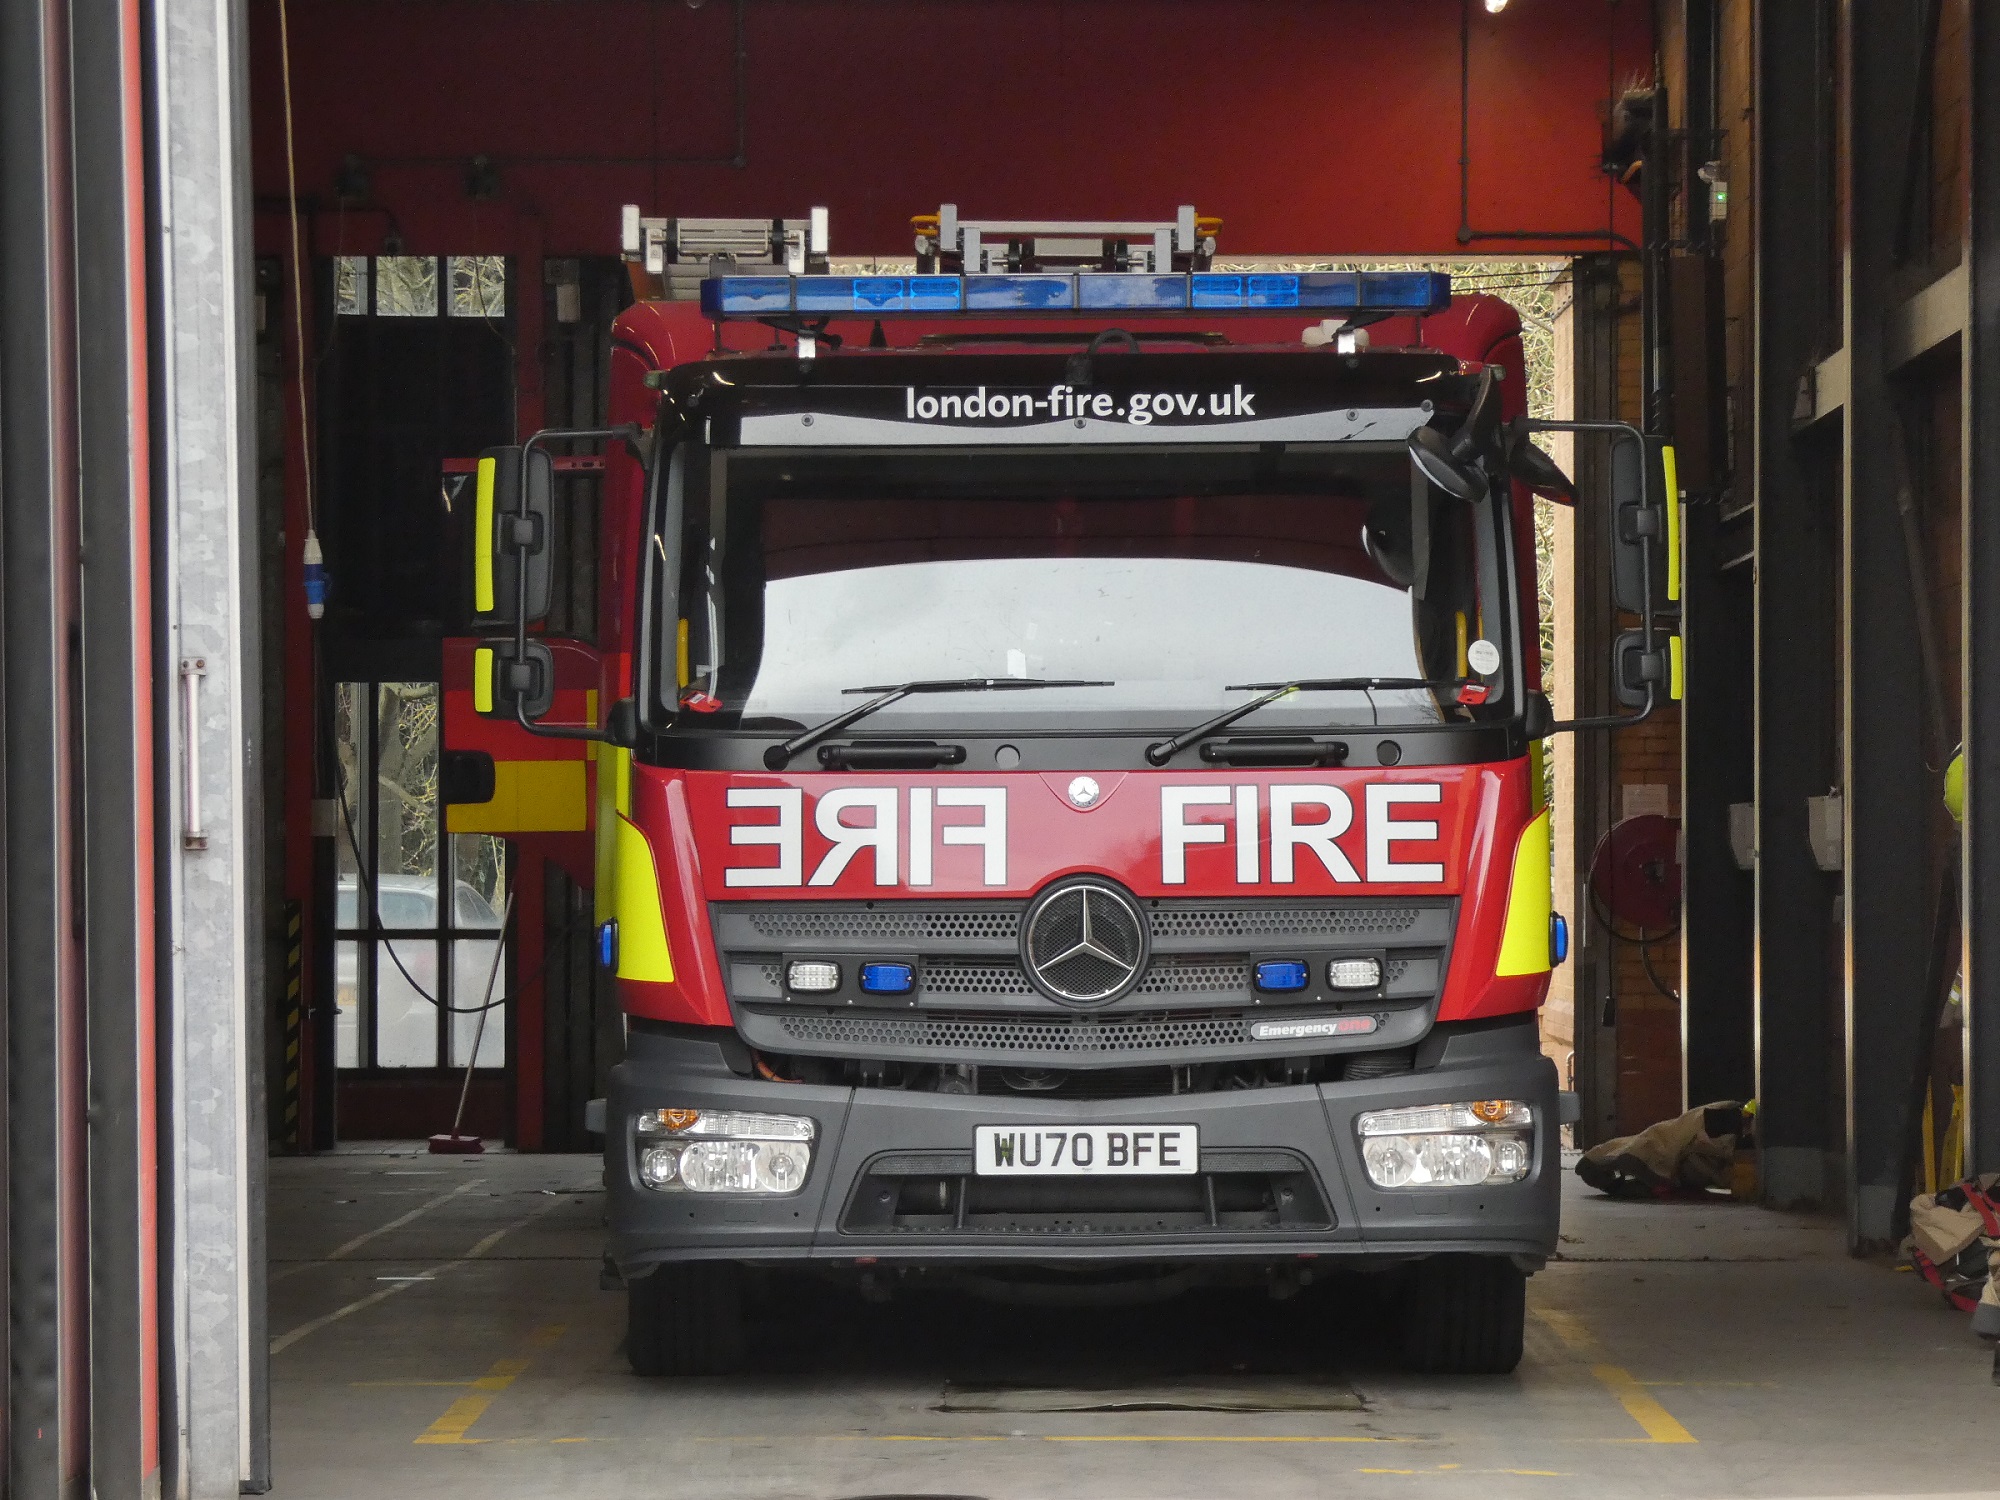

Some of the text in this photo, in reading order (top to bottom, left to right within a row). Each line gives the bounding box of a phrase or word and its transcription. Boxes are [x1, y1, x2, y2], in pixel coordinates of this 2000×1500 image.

[905, 384, 1256, 426] london-fire.gov.uk
[1161, 783, 1444, 884] FIRE
[1259, 1022, 1338, 1037] Emergency
[993, 1132, 1181, 1167] WU70 BFE
